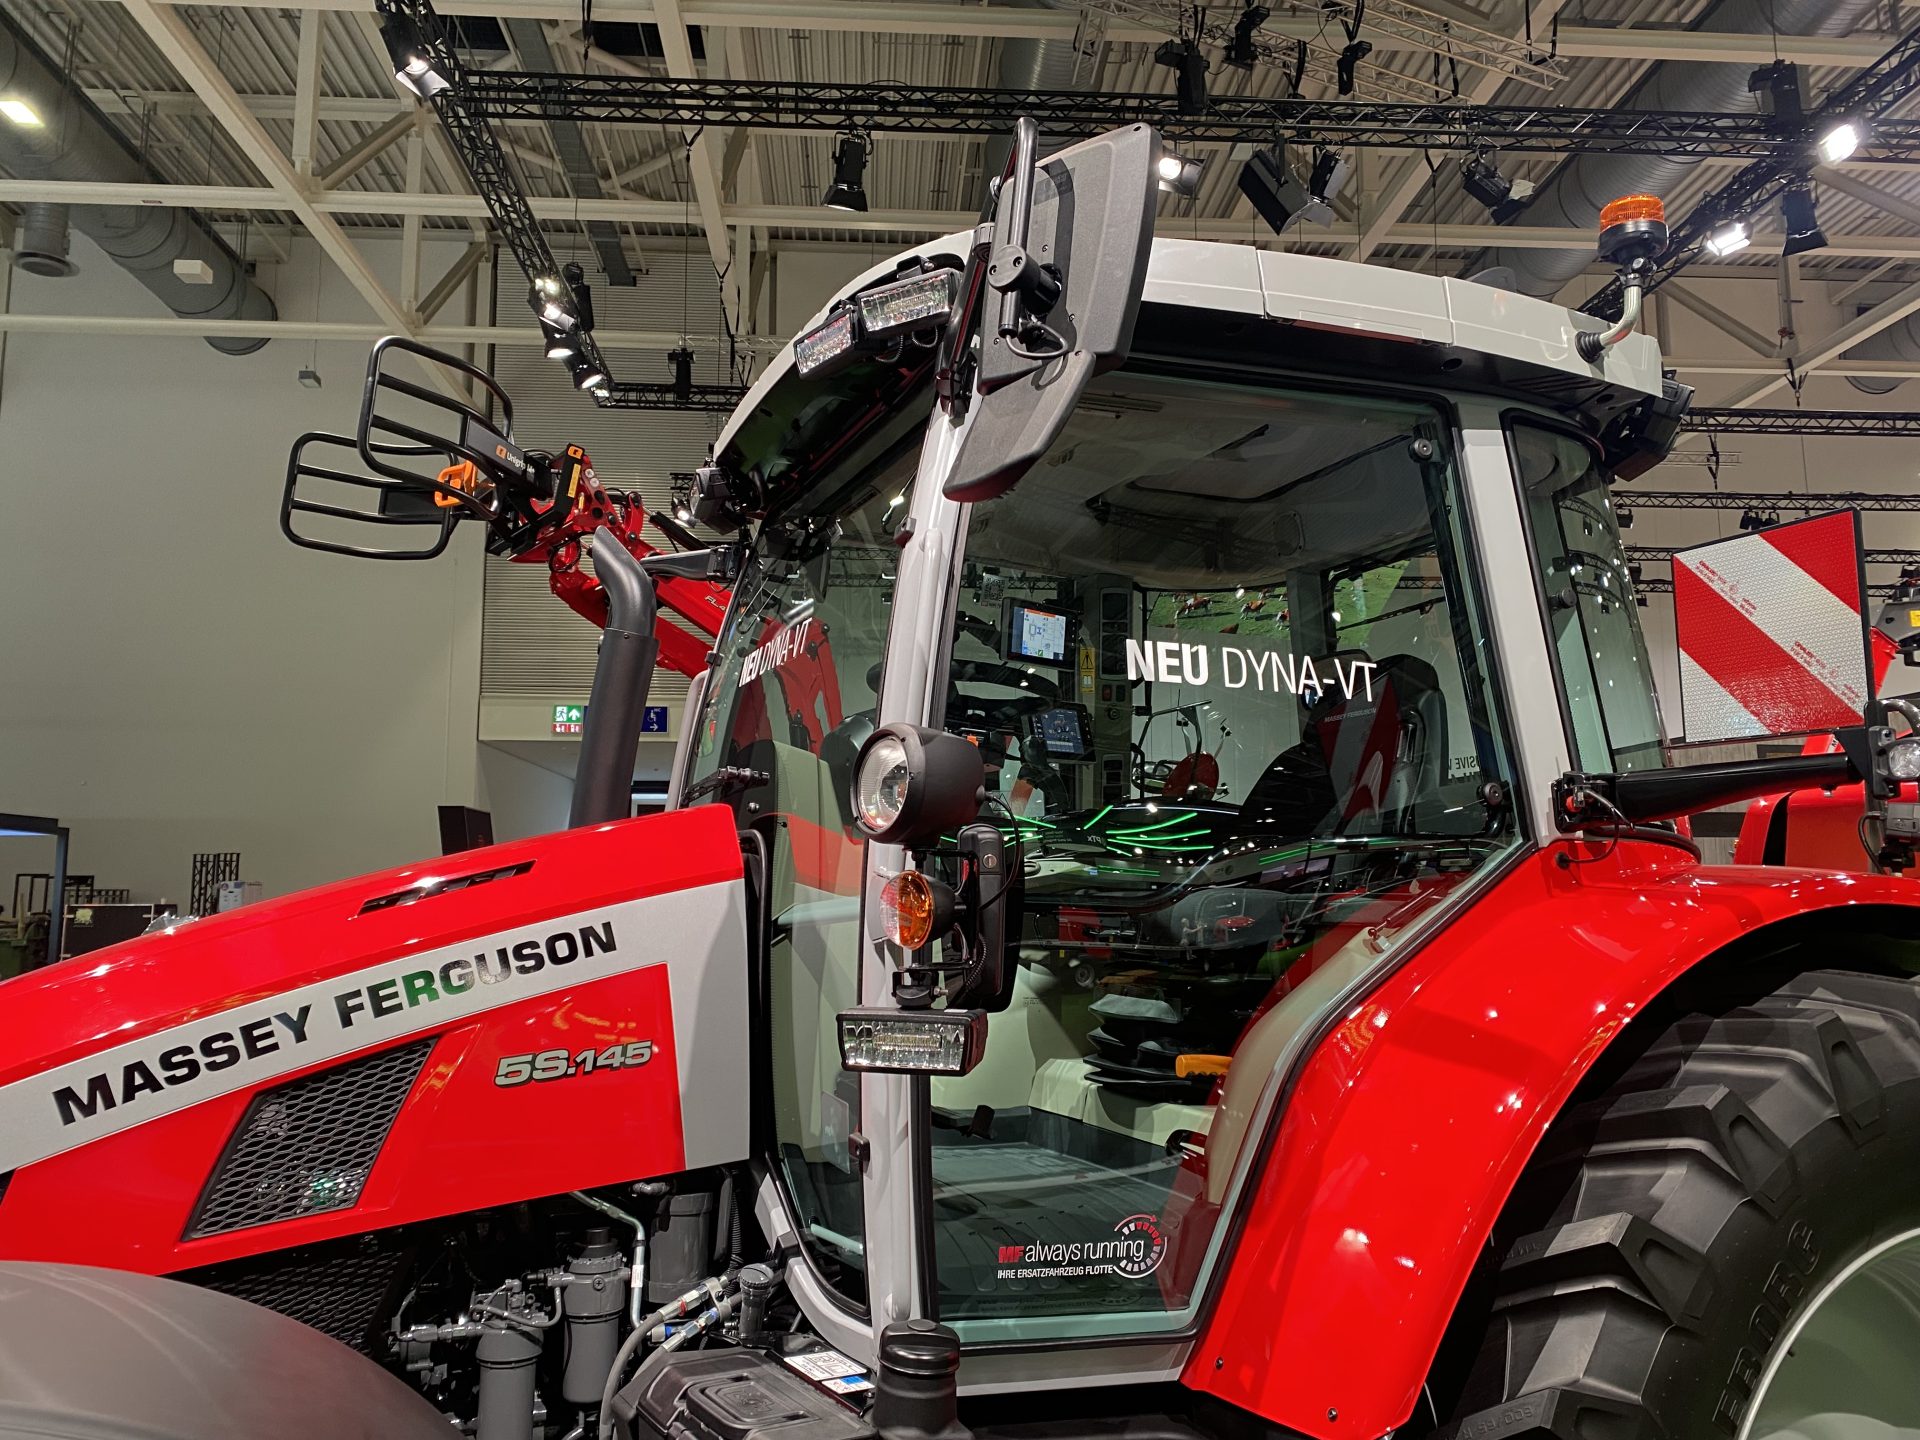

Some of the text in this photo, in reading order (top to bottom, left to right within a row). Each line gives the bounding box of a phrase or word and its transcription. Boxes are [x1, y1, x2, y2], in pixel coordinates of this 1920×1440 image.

[739, 617, 813, 687] NEU DYNA-VT
[1125, 639, 1209, 686] NEU
[1222, 647, 1377, 702] DYNA-VT
[52, 921, 617, 1126] MASSEY FERGUSON
[494, 1040, 653, 1088] 5S.145
[997, 1264, 1114, 1279] IHRE ERSATZFAHRZEUG FLOTTE
[998, 1236, 1144, 1265] MF always running
